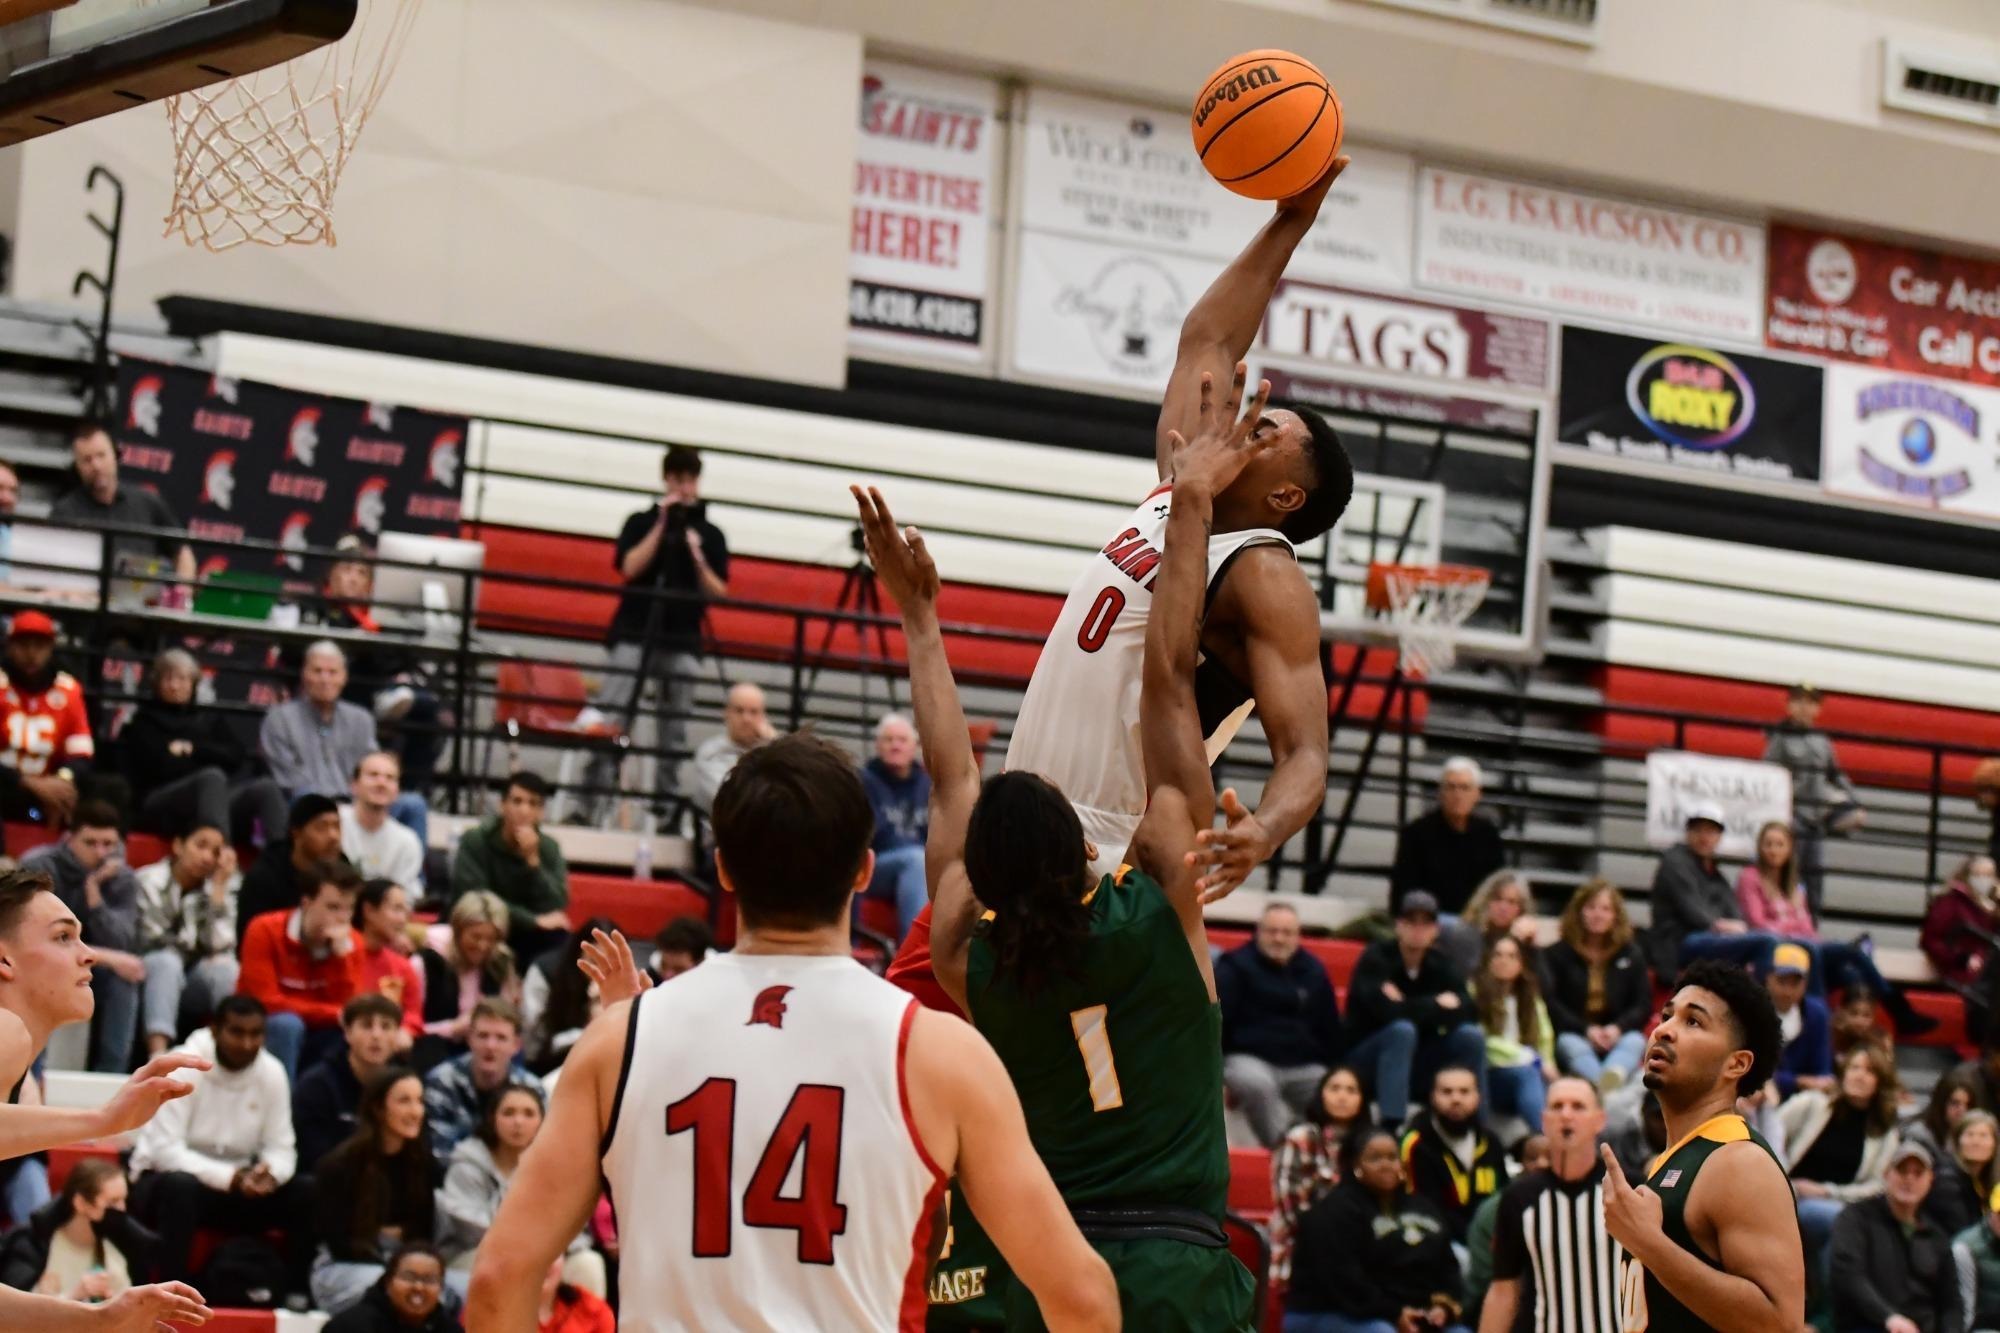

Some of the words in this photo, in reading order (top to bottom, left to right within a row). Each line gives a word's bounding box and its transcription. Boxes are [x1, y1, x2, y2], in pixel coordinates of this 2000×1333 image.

[867, 99, 985, 153] SAINTS
[1195, 64, 1282, 128] Wilson
[850, 205, 959, 268] HERE!
[1507, 185, 1684, 252] ISAACSON
[1889, 266, 1940, 308] Car
[1287, 301, 1450, 378] TAGS
[1919, 326, 1974, 369] Call
[1102, 527, 1163, 595] SAIN
[1077, 586, 1126, 653] 0
[1070, 1004, 1123, 1112] 1
[665, 1077, 847, 1265] 14
